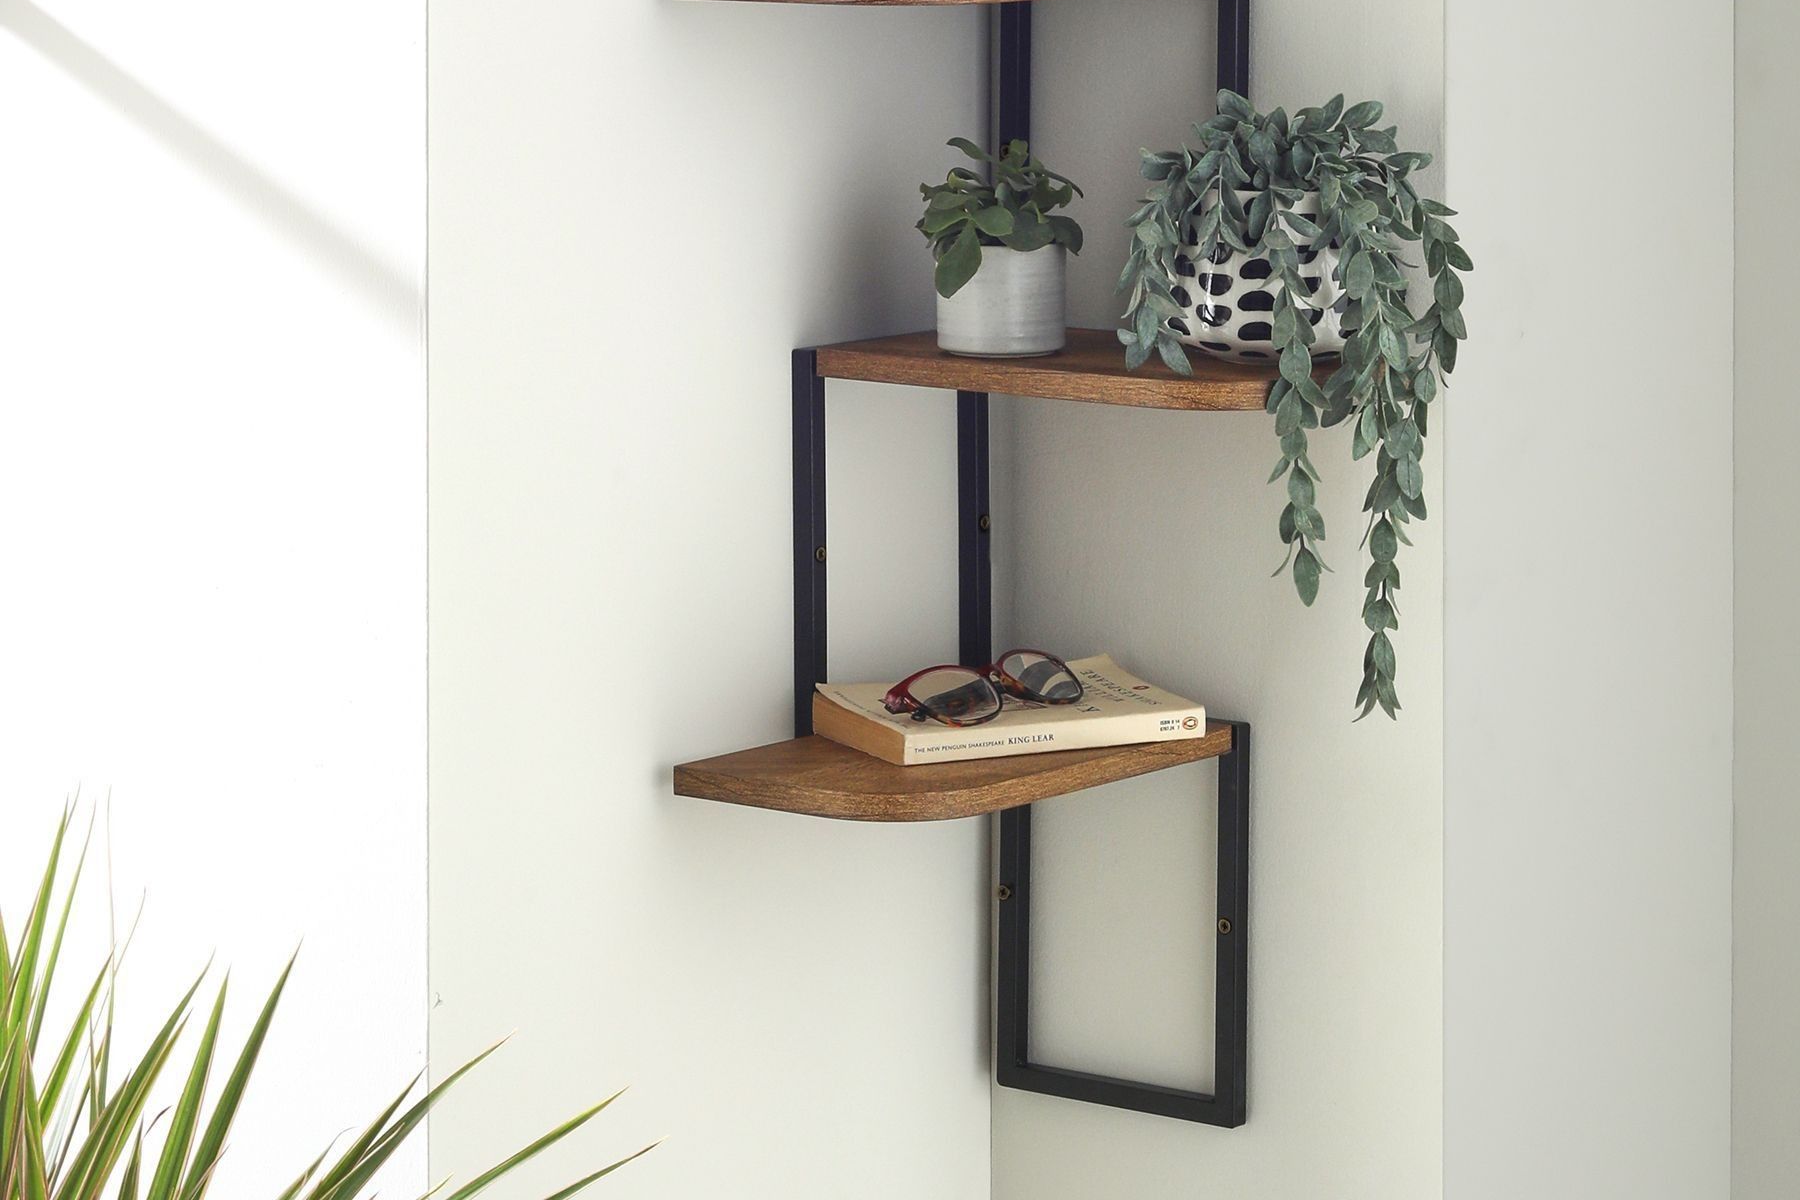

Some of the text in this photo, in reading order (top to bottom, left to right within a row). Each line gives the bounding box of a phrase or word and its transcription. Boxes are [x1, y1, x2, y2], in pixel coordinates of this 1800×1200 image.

[968, 740, 1005, 749] SHAKESPEARE
[1008, 735, 1030, 745] KING
[1032, 733, 1055, 743] LEAR
